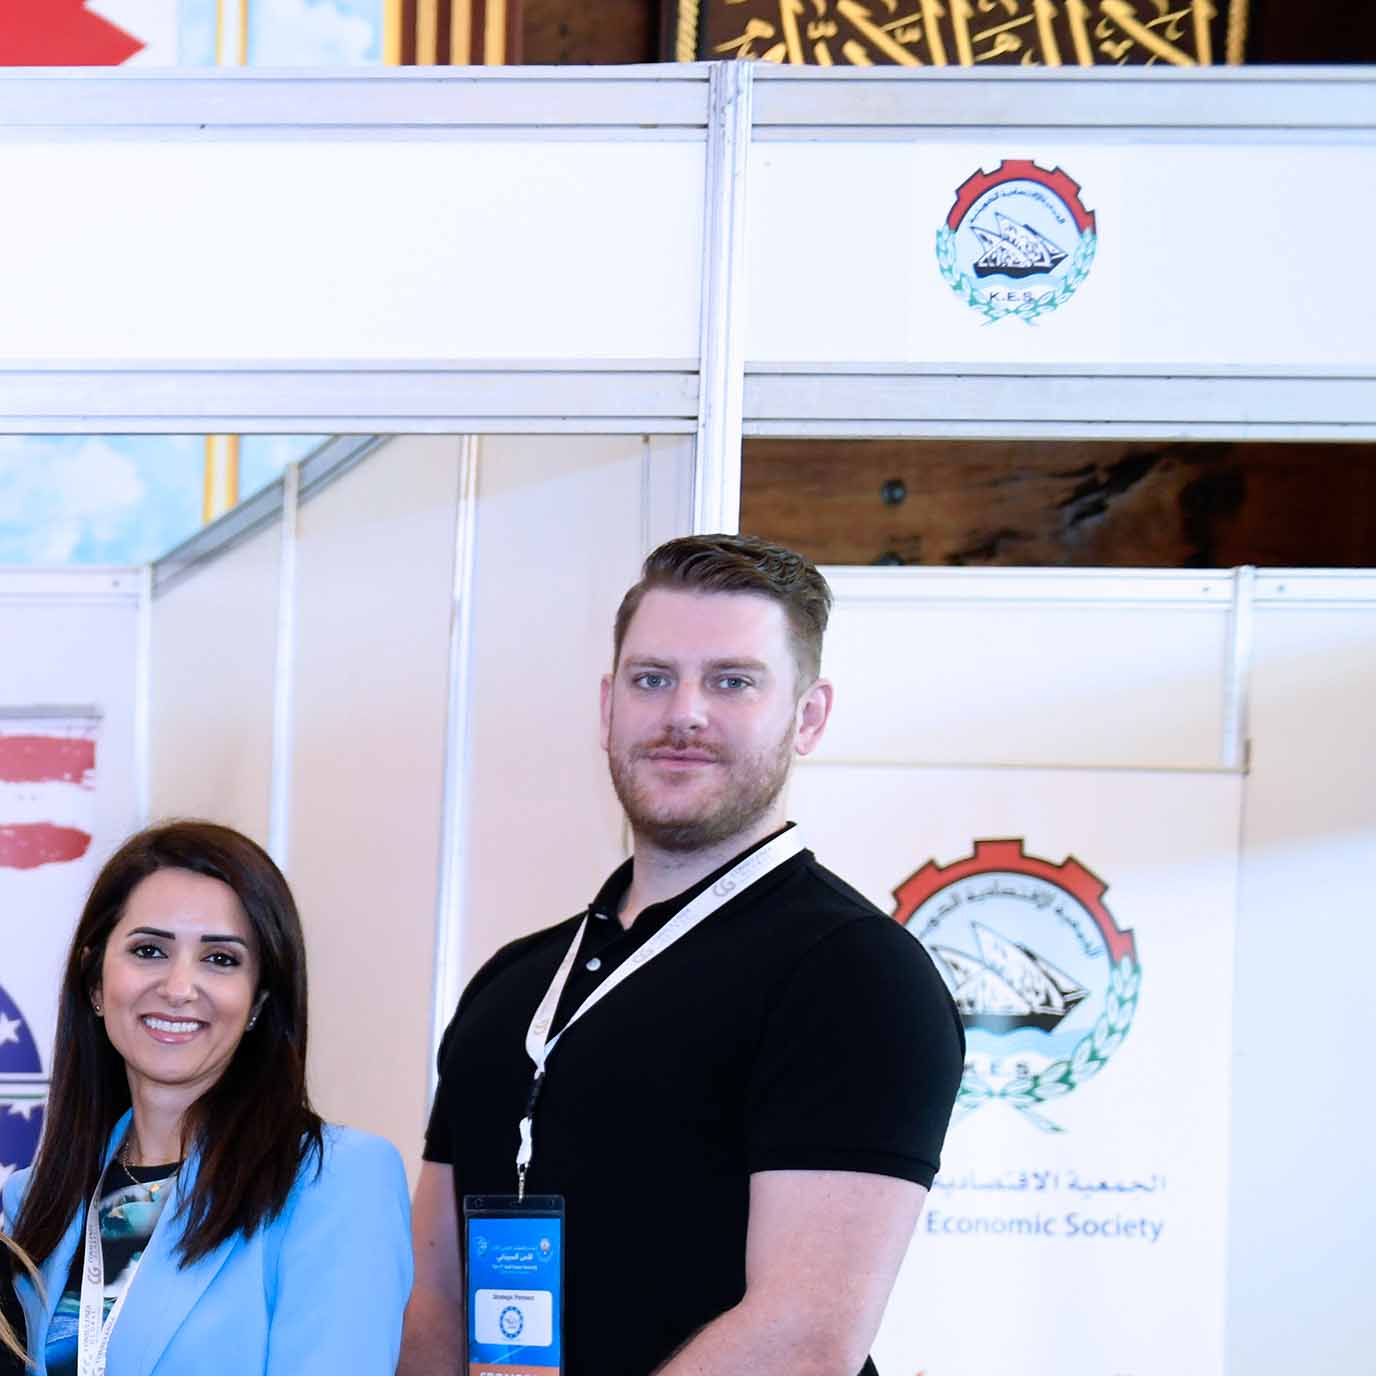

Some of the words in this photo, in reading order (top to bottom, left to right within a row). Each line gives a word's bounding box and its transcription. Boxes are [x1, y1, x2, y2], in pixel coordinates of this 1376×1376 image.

[1066, 1171, 1168, 1199] الجمعية
[926, 1209, 1058, 1236] Economic
[1064, 1211, 1164, 1243] Society
